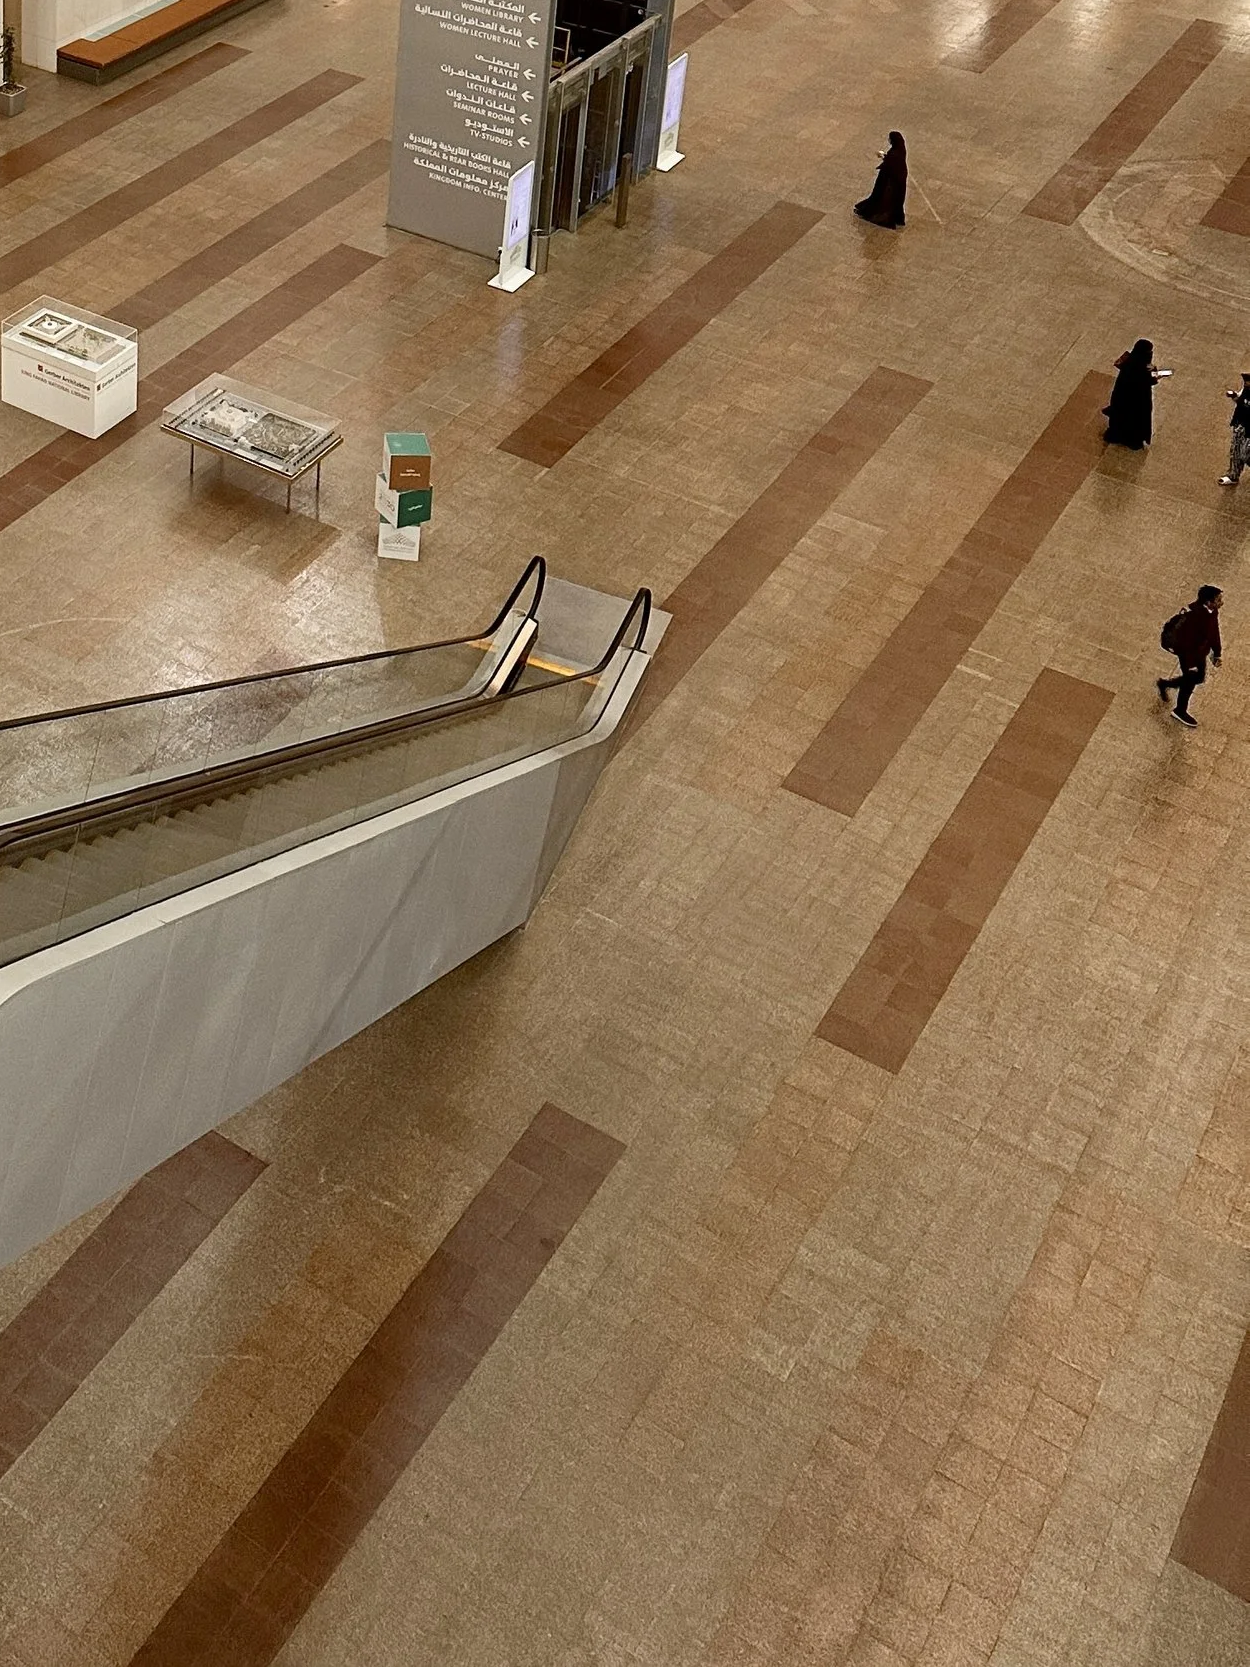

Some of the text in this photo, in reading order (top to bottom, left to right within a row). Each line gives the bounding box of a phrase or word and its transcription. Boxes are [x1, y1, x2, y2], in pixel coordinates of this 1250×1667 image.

[461, 2, 524, 24] WOMEN LIBRARY
[439, 21, 521, 48] WOMEN LECTURE HALL
[499, 24, 523, 38] قاعة
[488, 64, 519, 78] PRAYER
[466, 81, 516, 102] LECTURE HALL
[491, 77, 518, 91] قاعة
[453, 101, 515, 124] SEMINAR ROOMS
[485, 99, 516, 114] قاعات
[403, 142, 441, 158] HISTORICAL
[442, 152, 448, 160] &
[468, 160, 492, 174] BOOKS
[492, 168, 510, 179] HALL
[428, 172, 462, 187] KINGDOM
